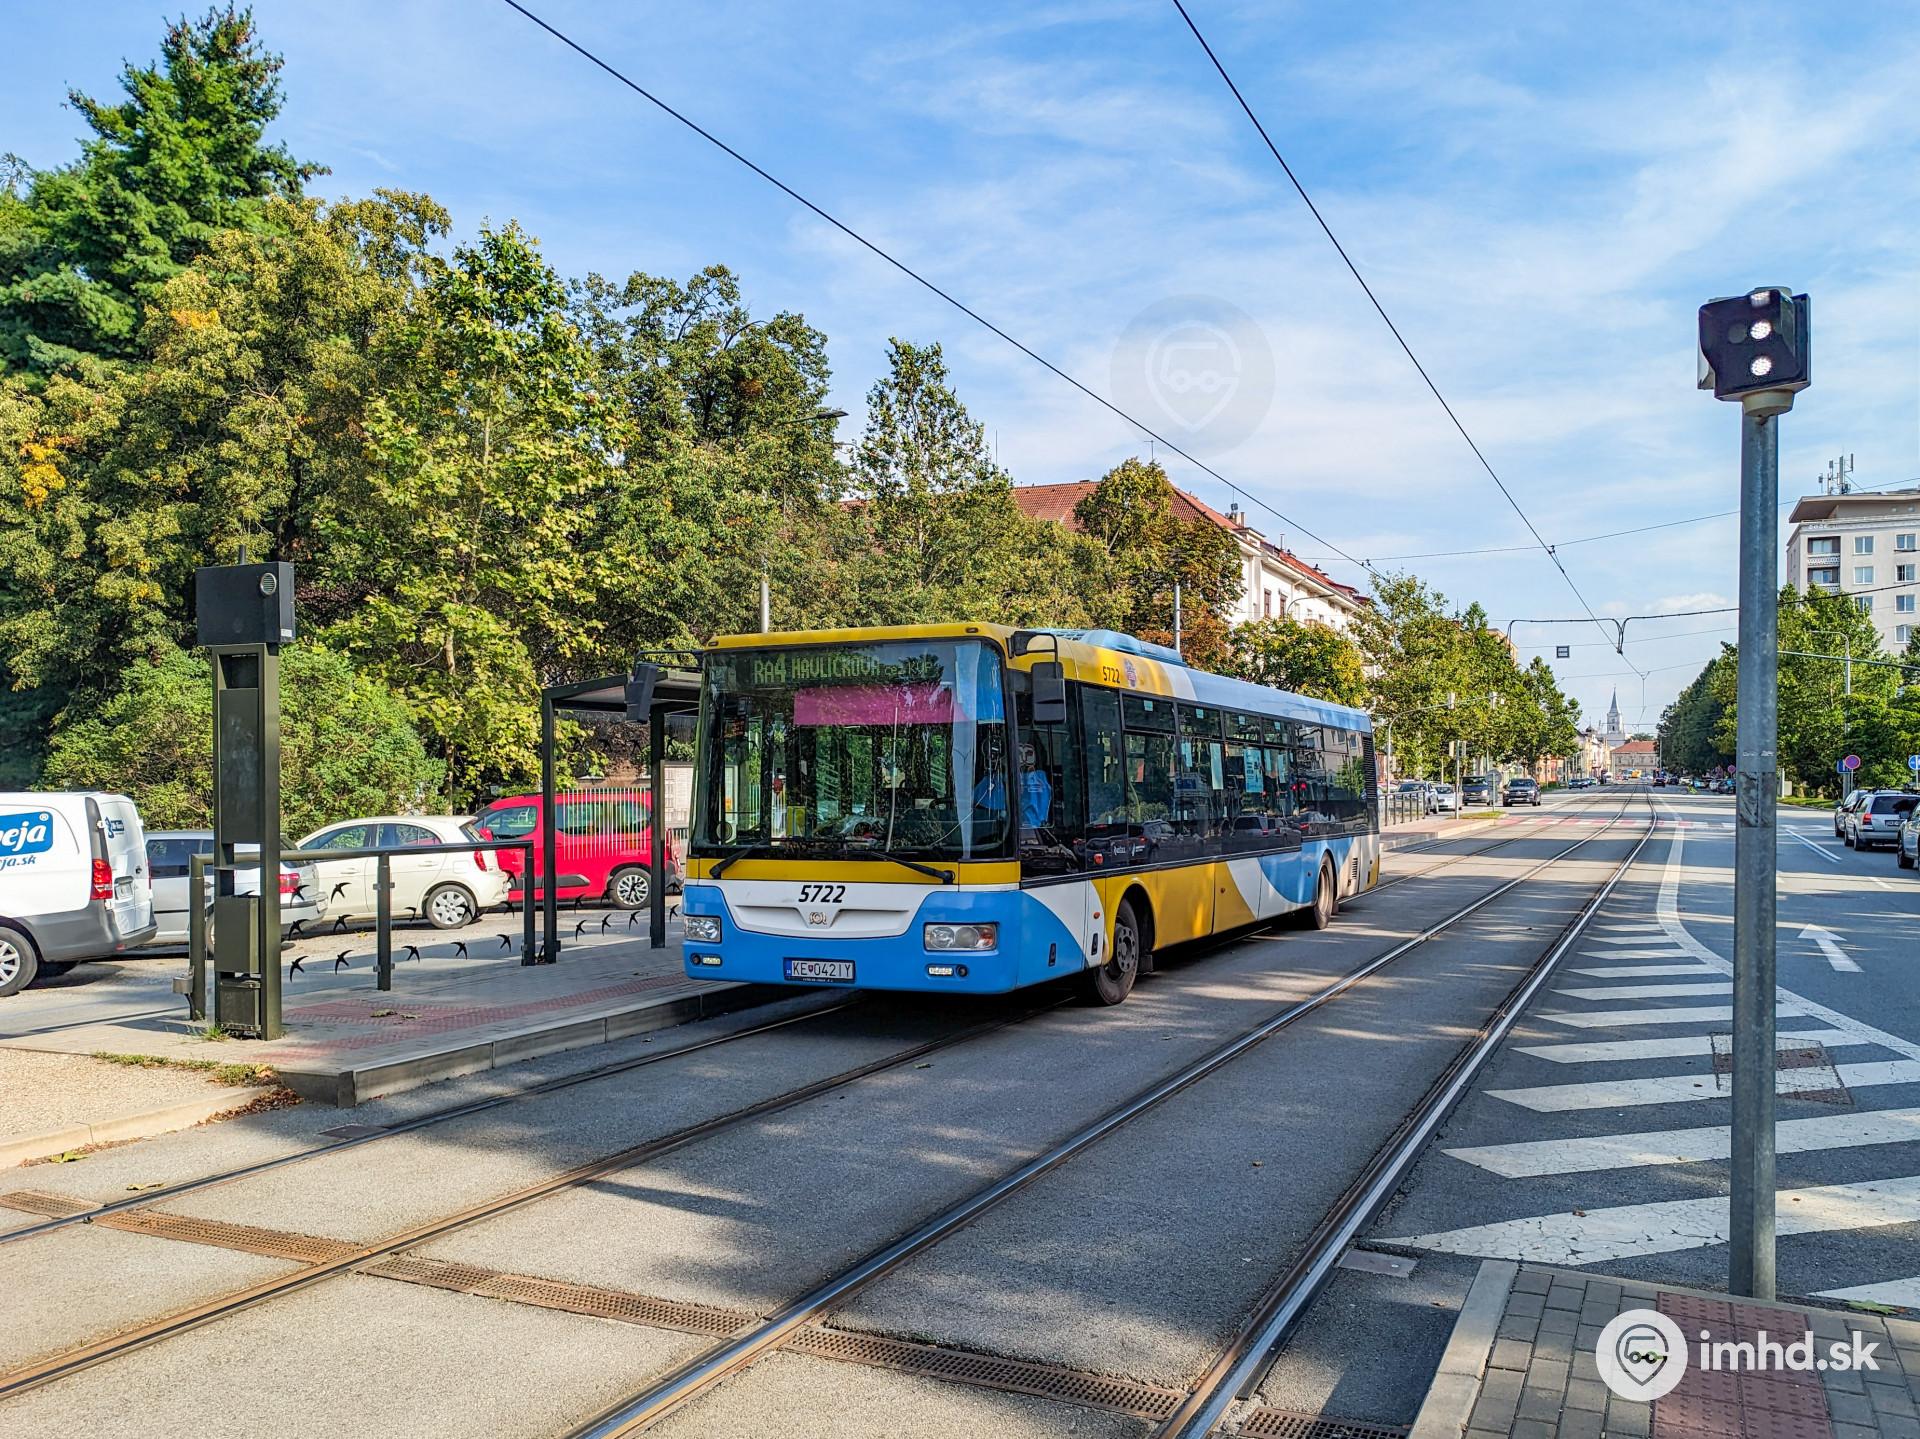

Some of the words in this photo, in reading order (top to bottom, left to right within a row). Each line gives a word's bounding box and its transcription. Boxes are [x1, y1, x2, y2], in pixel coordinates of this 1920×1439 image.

[1102, 665, 1121, 684] 5722
[0, 821, 47, 852] eja
[0, 855, 37, 872] ja.sk
[797, 884, 846, 904] 5722
[792, 962, 808, 976] KE
